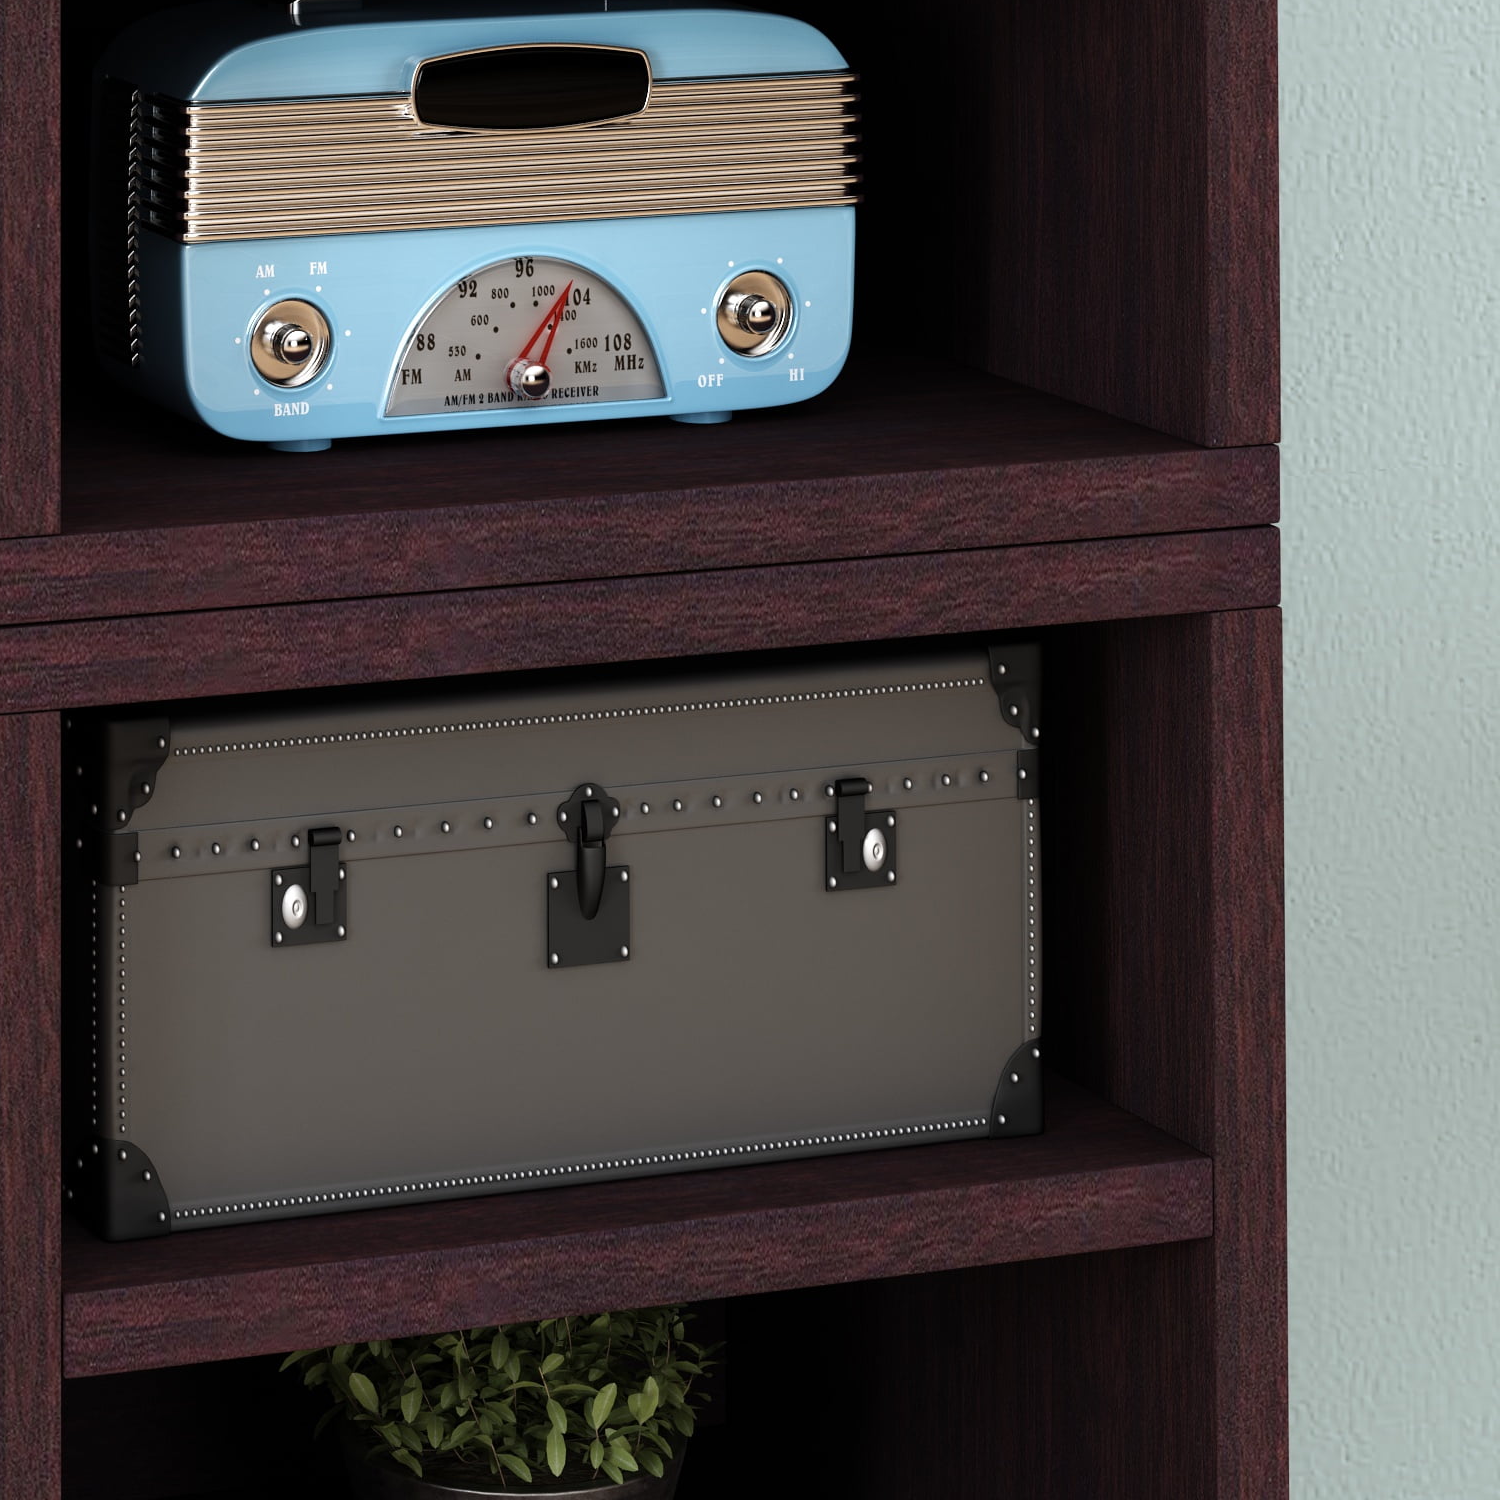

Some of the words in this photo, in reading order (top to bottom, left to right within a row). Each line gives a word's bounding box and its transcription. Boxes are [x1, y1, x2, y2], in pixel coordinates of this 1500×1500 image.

[255, 265, 275, 278] AM
[309, 261, 328, 275] FM
[515, 257, 534, 278] 96
[458, 280, 478, 298] 92
[491, 287, 509, 299] 800
[531, 285, 555, 297] 1000
[471, 314, 489, 326] 600
[416, 333, 435, 351] 88
[575, 337, 598, 349] 1600
[604, 333, 632, 352] 108
[448, 345, 466, 357] 530
[574, 360, 597, 374] KMz
[614, 354, 644, 371] MHz
[401, 368, 422, 385] FM
[454, 368, 471, 382] AM
[697, 374, 724, 388] OFF
[789, 368, 805, 381] HI
[444, 393, 476, 406] AM/FM
[479, 393, 485, 403] 2
[488, 392, 514, 402] BAND
[551, 385, 599, 399] RECEIVER
[274, 402, 310, 417] BAND
